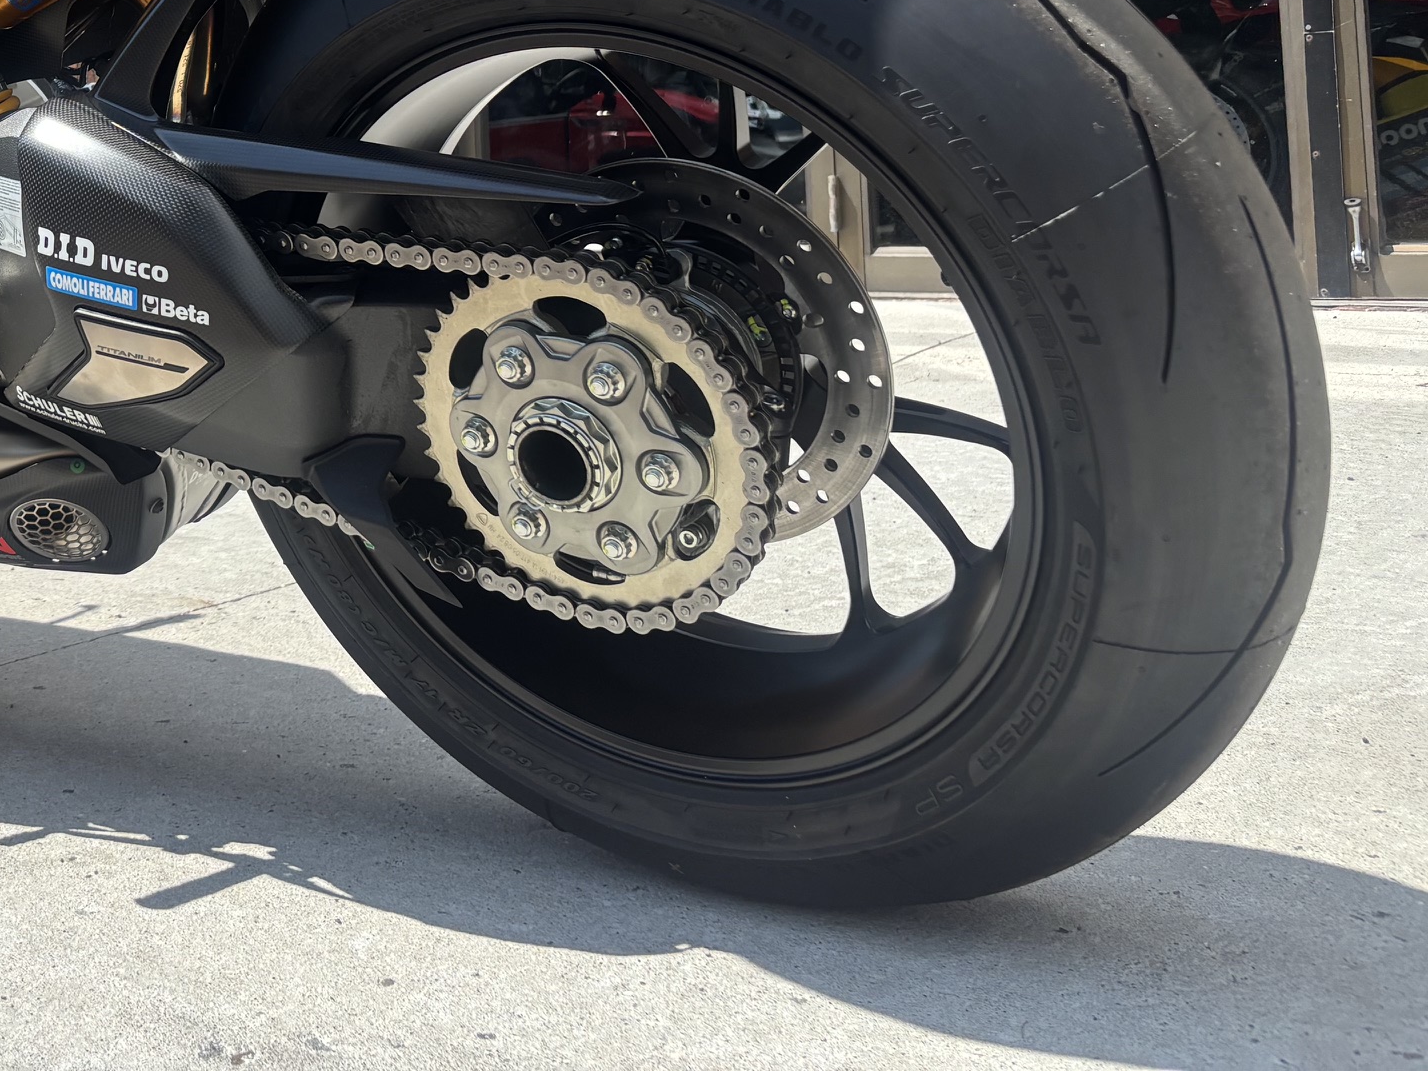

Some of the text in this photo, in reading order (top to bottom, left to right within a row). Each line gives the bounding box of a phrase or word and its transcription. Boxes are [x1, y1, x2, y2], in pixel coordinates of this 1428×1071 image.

[38, 226, 169, 282] D.I.D IVECO
[49, 271, 133, 307] COMOLI FERRARI
[160, 298, 210, 326] Beta
[97, 345, 162, 364] TITANIUM
[16, 385, 88, 424] SCHULER
[977, 541, 1093, 771] SUPERCORSA
[500, 745, 601, 802] 200/60
